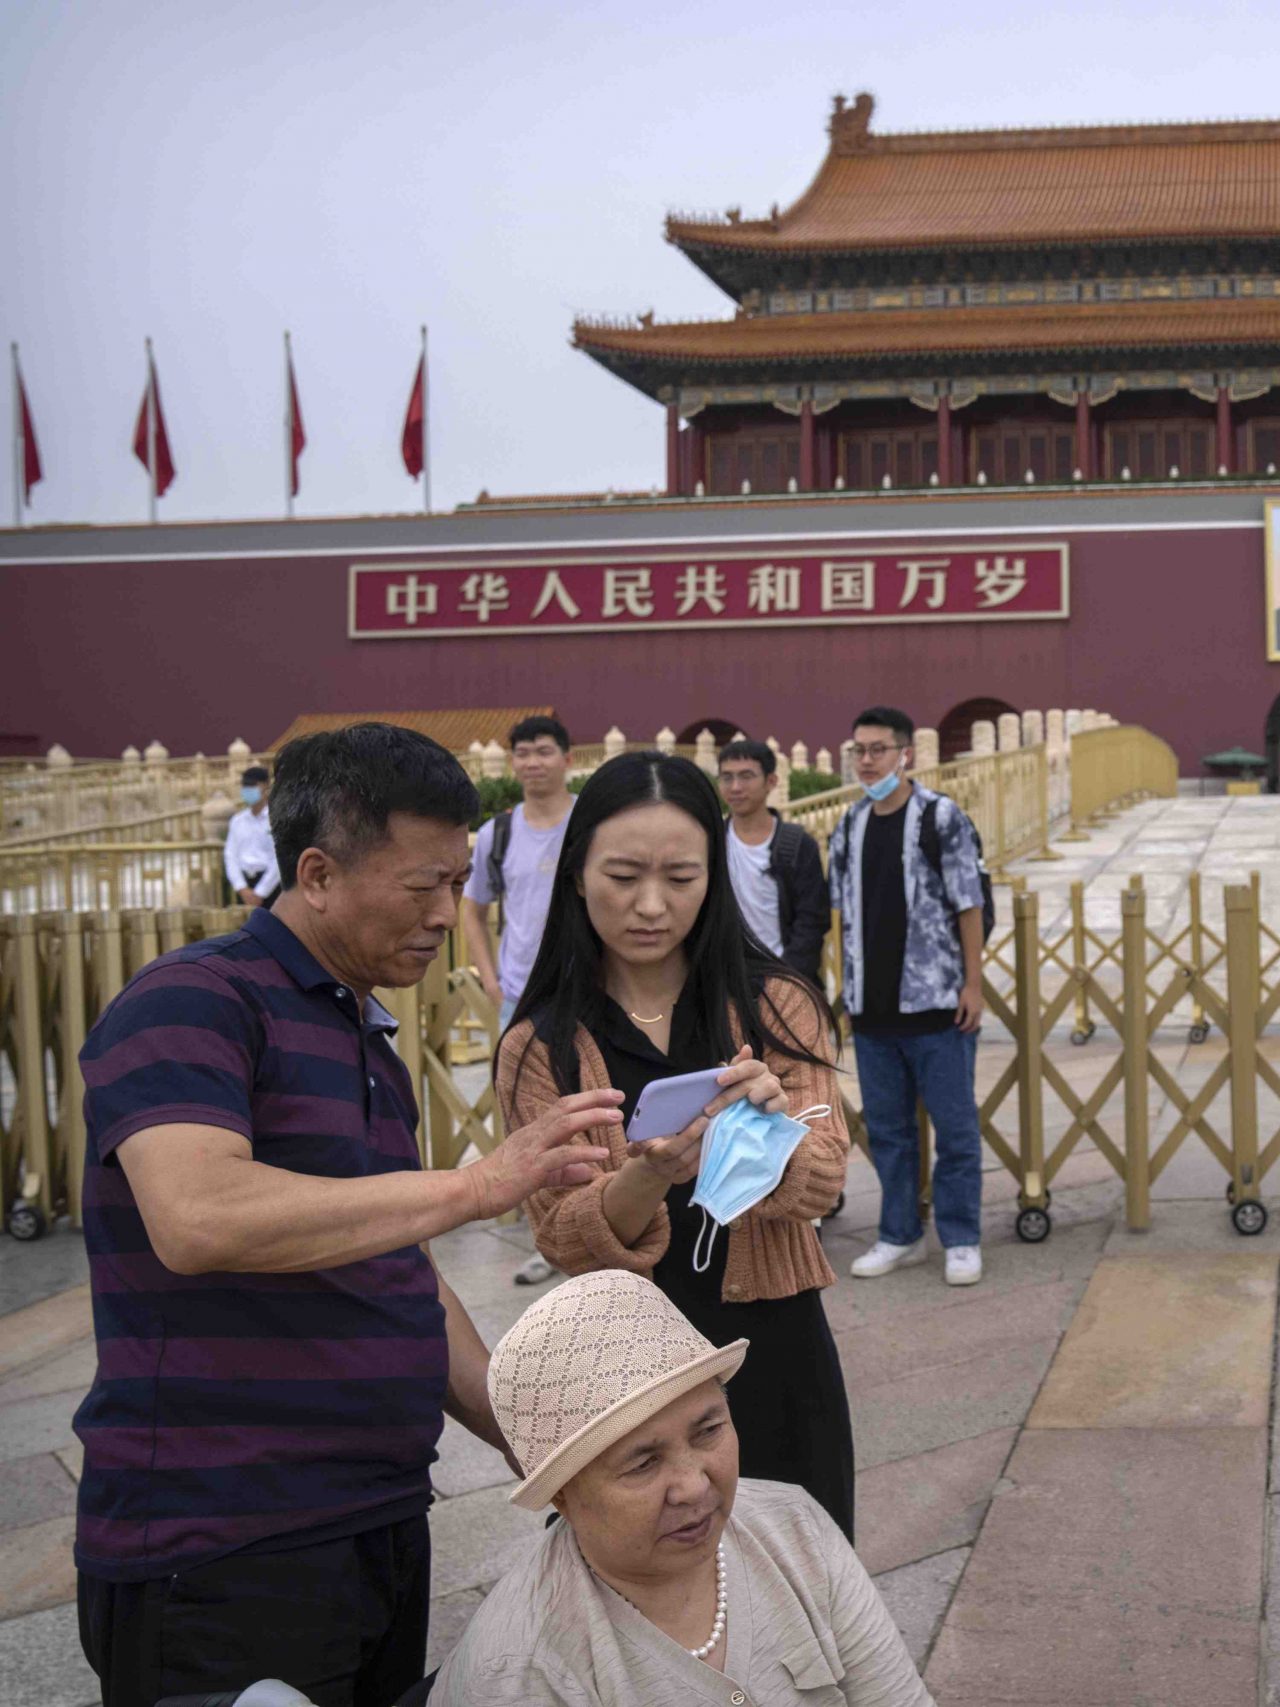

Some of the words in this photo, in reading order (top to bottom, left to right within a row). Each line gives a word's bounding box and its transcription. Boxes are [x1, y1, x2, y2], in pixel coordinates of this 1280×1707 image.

[385, 556, 1029, 624] 中华人民共和国万岁
